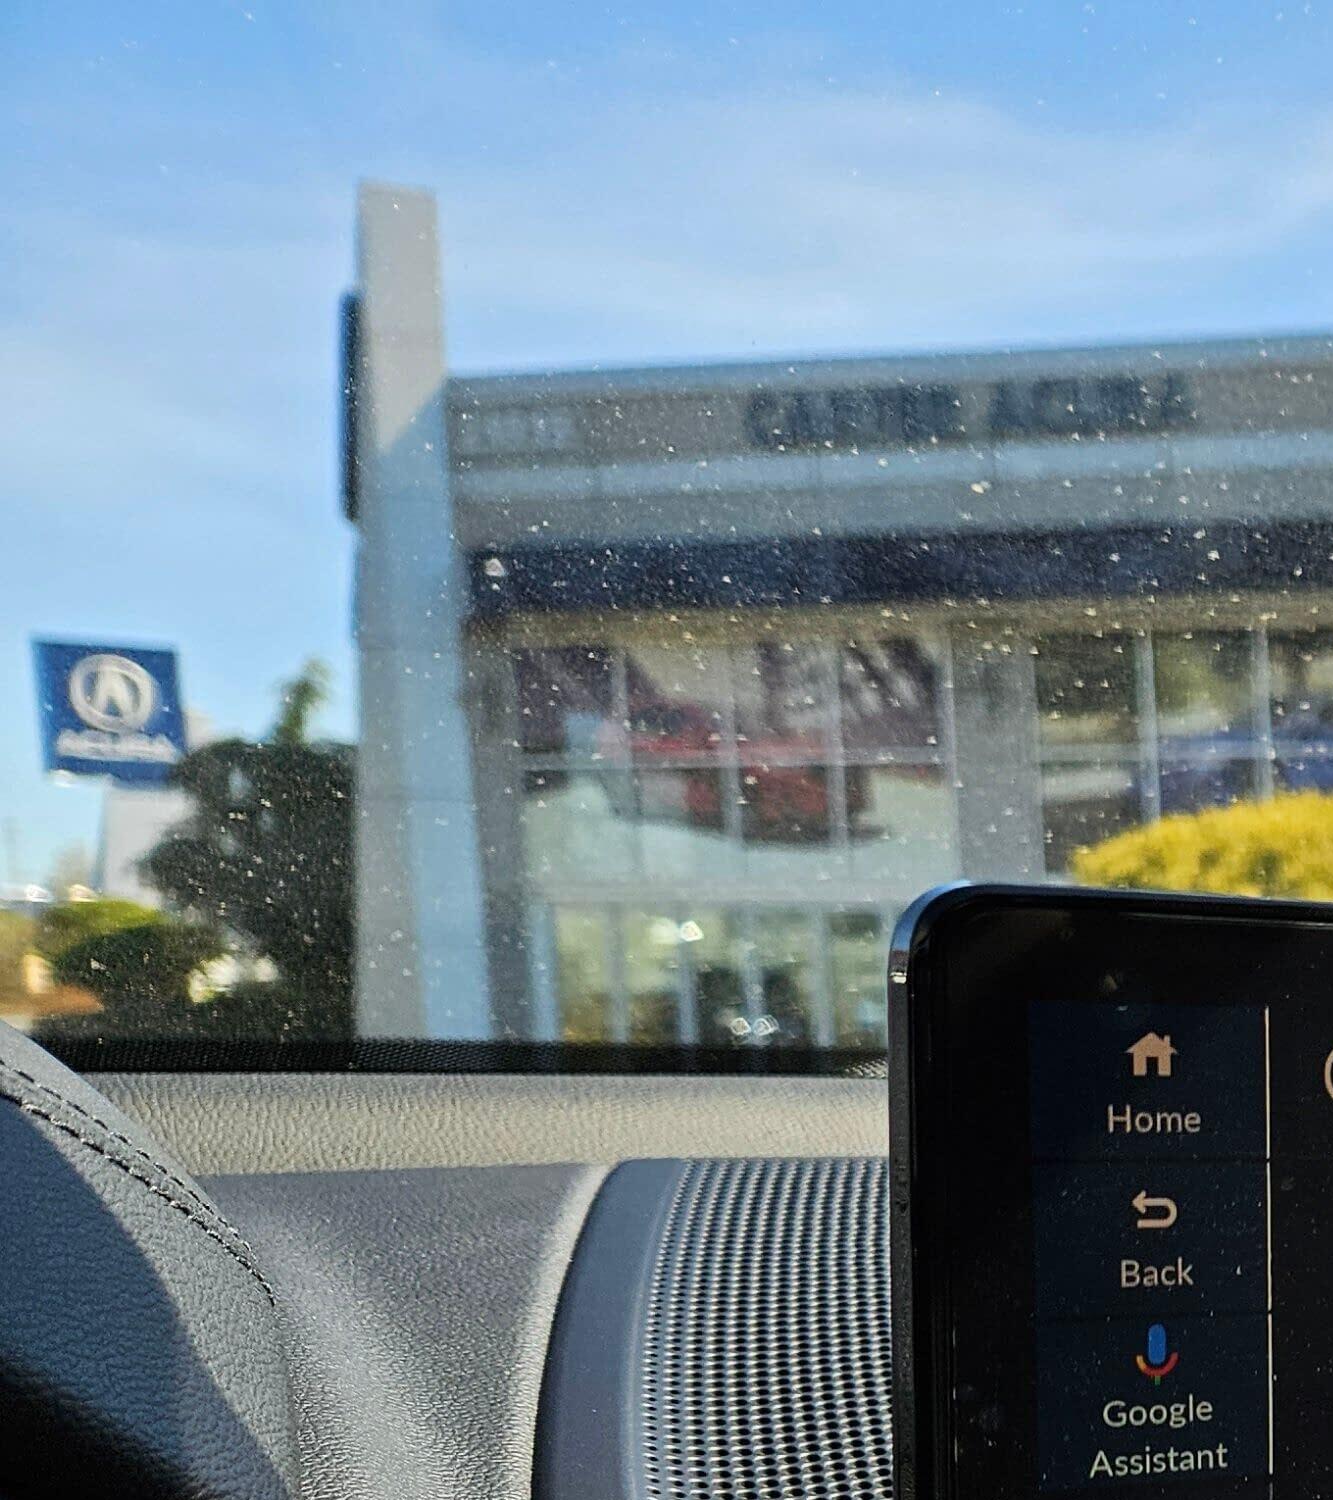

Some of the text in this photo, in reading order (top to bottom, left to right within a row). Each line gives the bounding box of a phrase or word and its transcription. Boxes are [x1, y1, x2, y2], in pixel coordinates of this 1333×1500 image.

[1106, 1104, 1202, 1134] Home
[1119, 1257, 1194, 1289] Back
[1102, 1394, 1214, 1430] Google
[1088, 1442, 1229, 1479] Assistant
